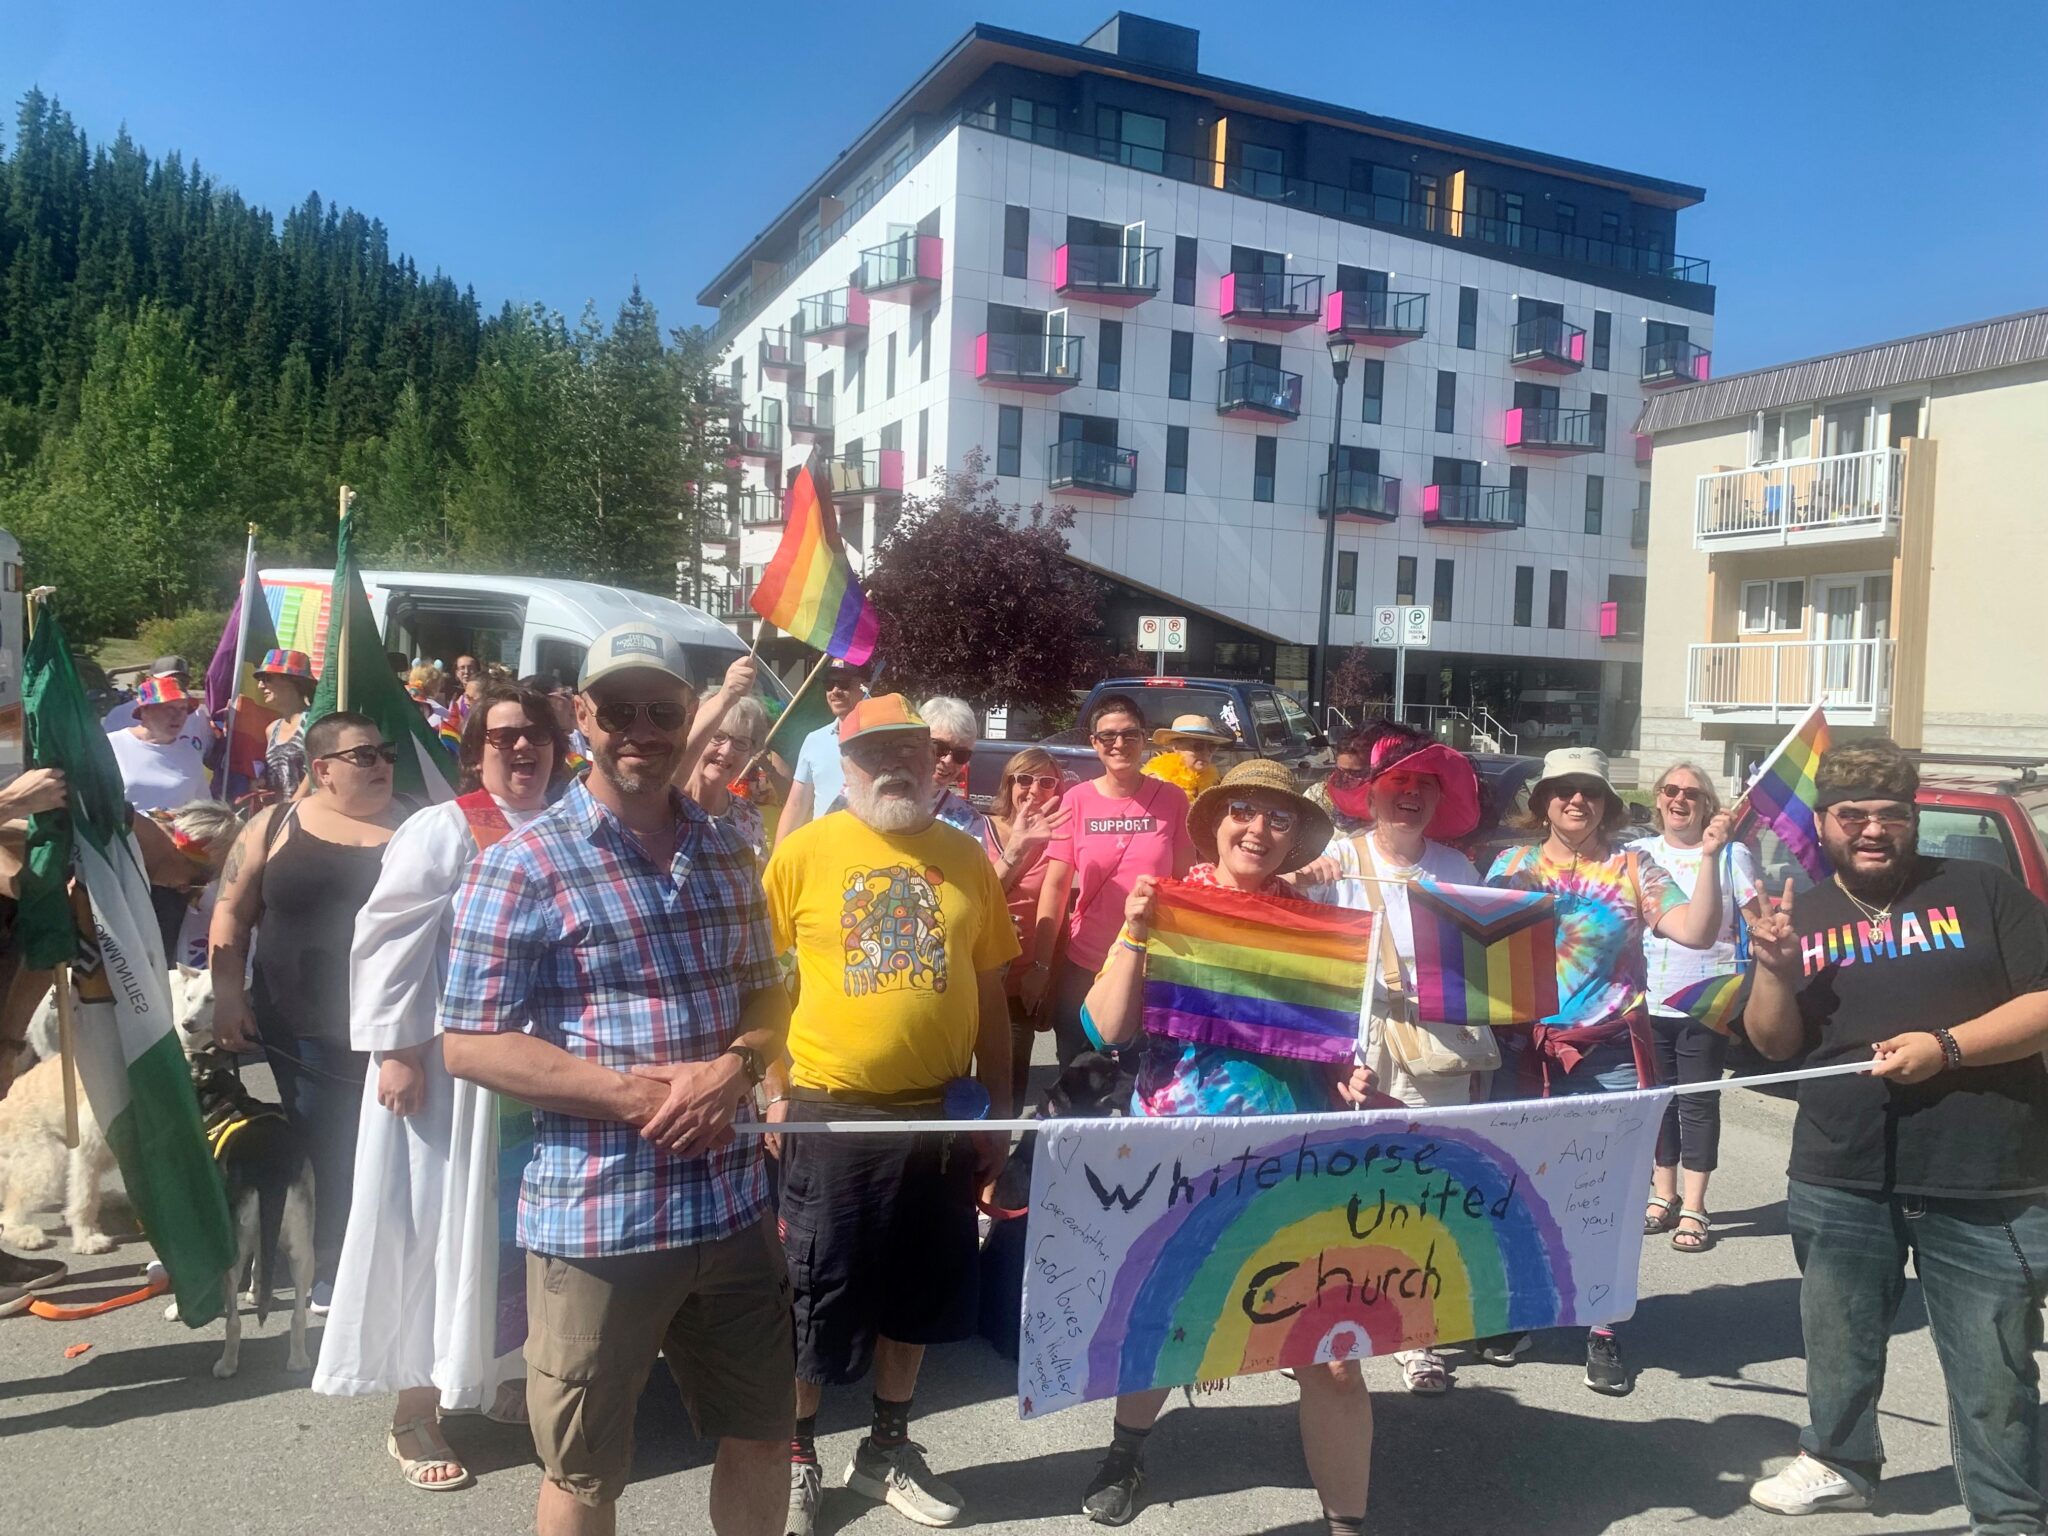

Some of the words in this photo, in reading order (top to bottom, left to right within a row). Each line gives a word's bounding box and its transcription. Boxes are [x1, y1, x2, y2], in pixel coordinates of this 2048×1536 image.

[1090, 819, 1150, 832] SUPPORT
[1800, 906, 1965, 977] HUMAN
[1083, 1132, 1440, 1213] Whitehorse
[1558, 1135, 1608, 1164] And
[1565, 1193, 1600, 1213] loves
[1574, 1171, 1606, 1190] God
[1347, 1174, 1517, 1239] United
[1035, 1234, 1077, 1284] God
[1242, 1240, 1441, 1324] Church
[1037, 1311, 1056, 1334] all
[1055, 1283, 1083, 1338] loves
